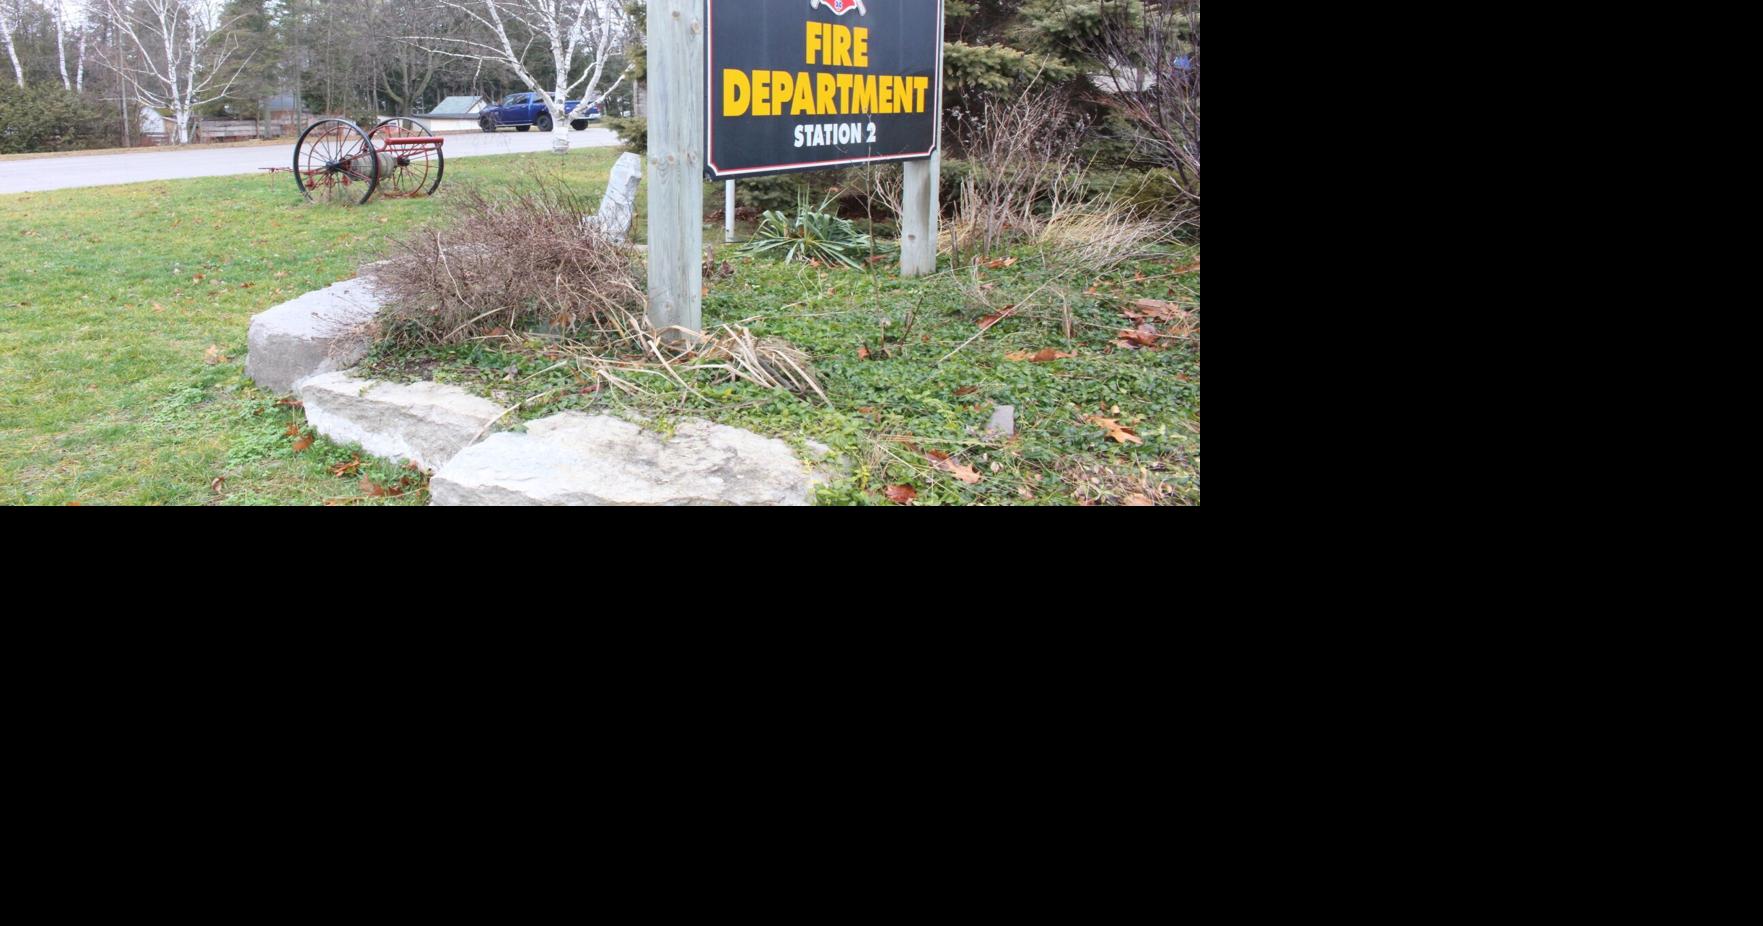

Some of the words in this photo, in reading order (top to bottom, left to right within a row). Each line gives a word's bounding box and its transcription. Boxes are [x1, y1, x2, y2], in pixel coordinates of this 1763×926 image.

[806, 21, 868, 67] FIRE
[722, 68, 929, 117] DEPARTMENT
[794, 123, 862, 147] STATION
[866, 122, 876, 143] 2
